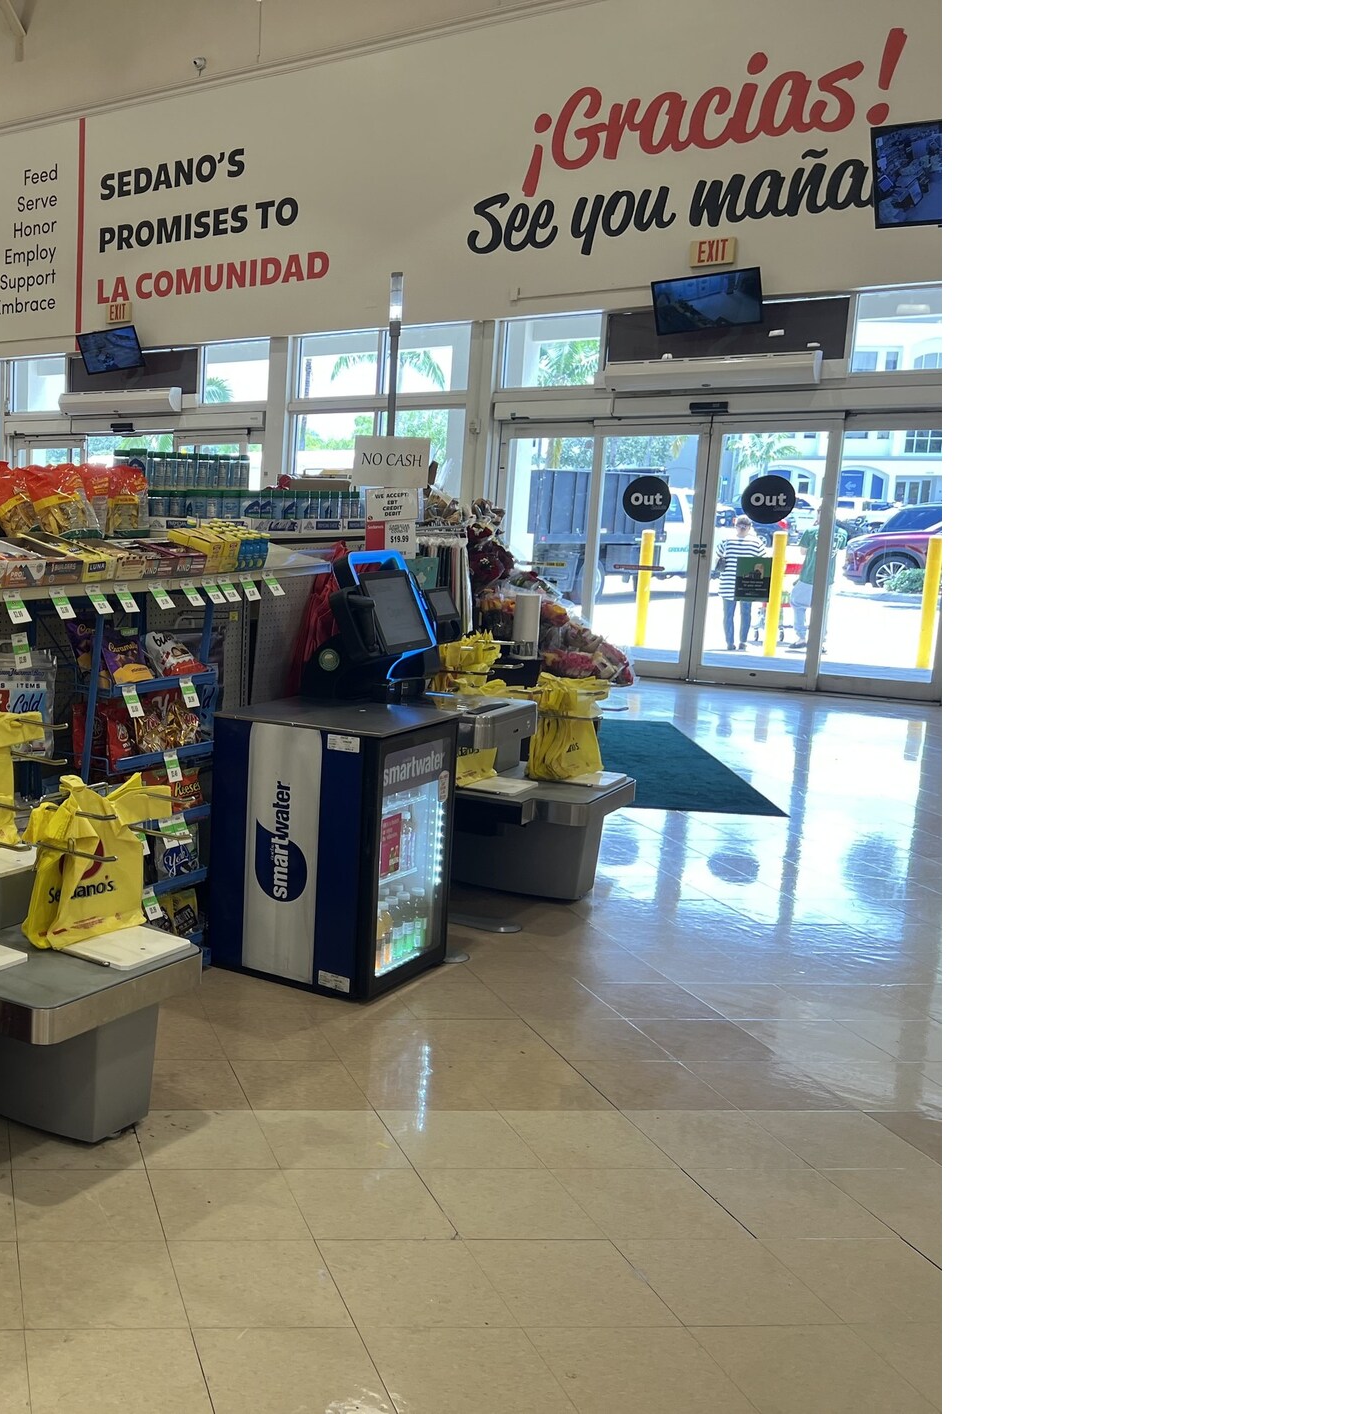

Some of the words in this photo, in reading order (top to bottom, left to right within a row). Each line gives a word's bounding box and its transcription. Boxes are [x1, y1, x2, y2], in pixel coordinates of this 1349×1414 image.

[521, 27, 907, 197] ¡Gracias!
[24, 163, 58, 186] Feed
[100, 148, 246, 200] SEDANO'S
[17, 193, 57, 213] Serve
[466, 192, 559, 254] See
[570, 185, 675, 255] you
[689, 148, 875, 227] maña
[13, 220, 57, 239] Honor
[99, 204, 248, 253] PROMISES
[255, 197, 299, 229] TO
[4, 244, 57, 266] Employ
[697, 238, 728, 263] EXIT
[0, 268, 56, 293] Support
[97, 276, 130, 304] LA
[136, 251, 330, 300] COMUNIDAD
[109, 303, 127, 321] EXIT
[362, 453, 383, 465] NO
[386, 453, 422, 467] CASH
[631, 492, 663, 506] Out
[751, 492, 787, 507] Out
[390, 535, 409, 543] $19.99
[89, 562, 105, 572] LUNA
[176, 564, 191, 572] KIND
[13, 693, 43, 713] Cold
[383, 750, 446, 786] smartwater
[175, 781, 200, 797] Reese's
[272, 781, 291, 899] smartwater
